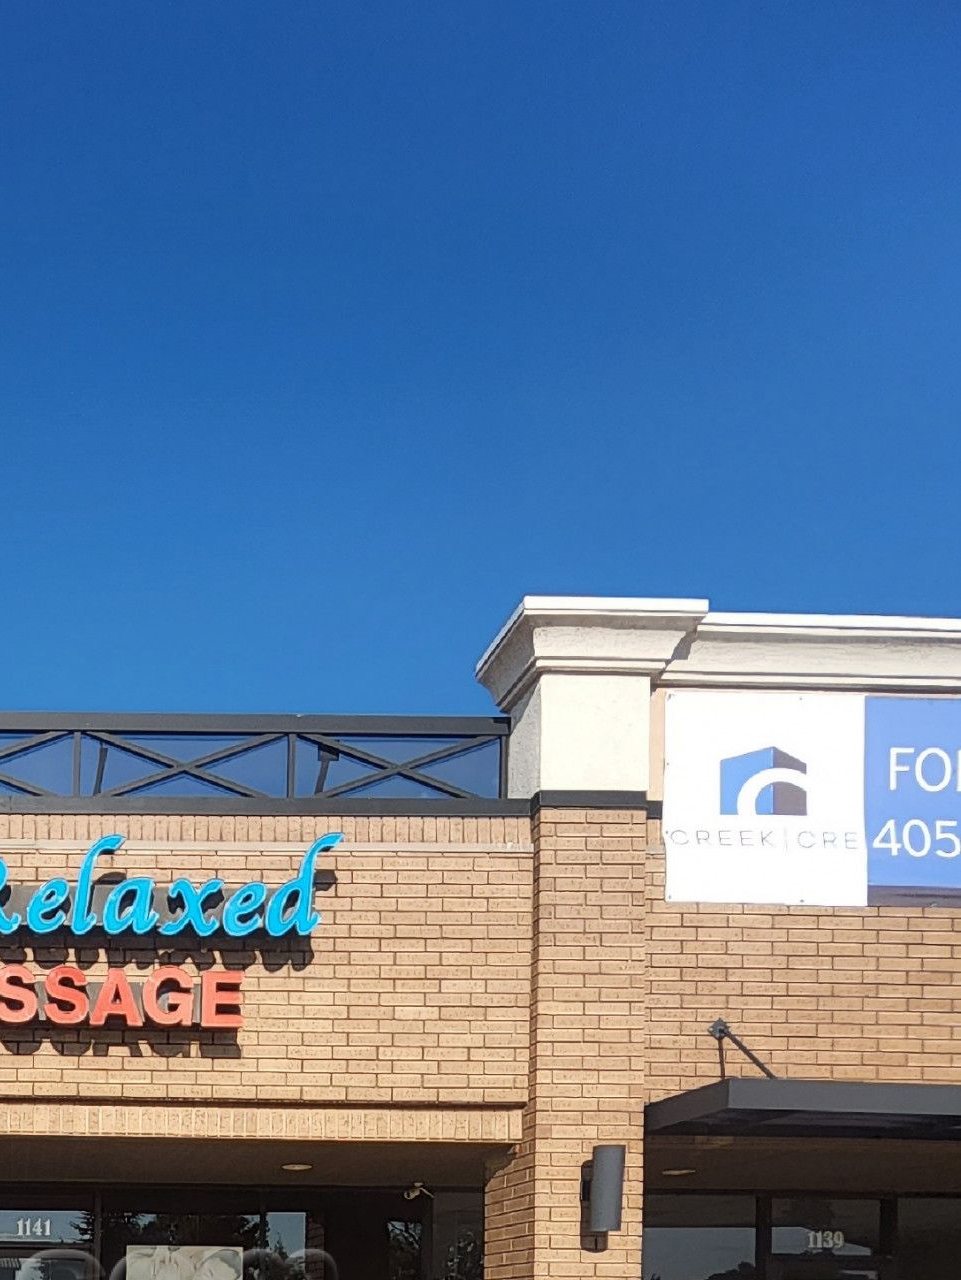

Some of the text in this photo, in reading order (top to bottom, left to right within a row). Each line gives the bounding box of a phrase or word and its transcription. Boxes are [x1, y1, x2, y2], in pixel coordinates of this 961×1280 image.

[670, 829, 860, 850] CREEK CRE
[16, 1217, 52, 1237] 1141
[807, 1230, 845, 1249] 1139
